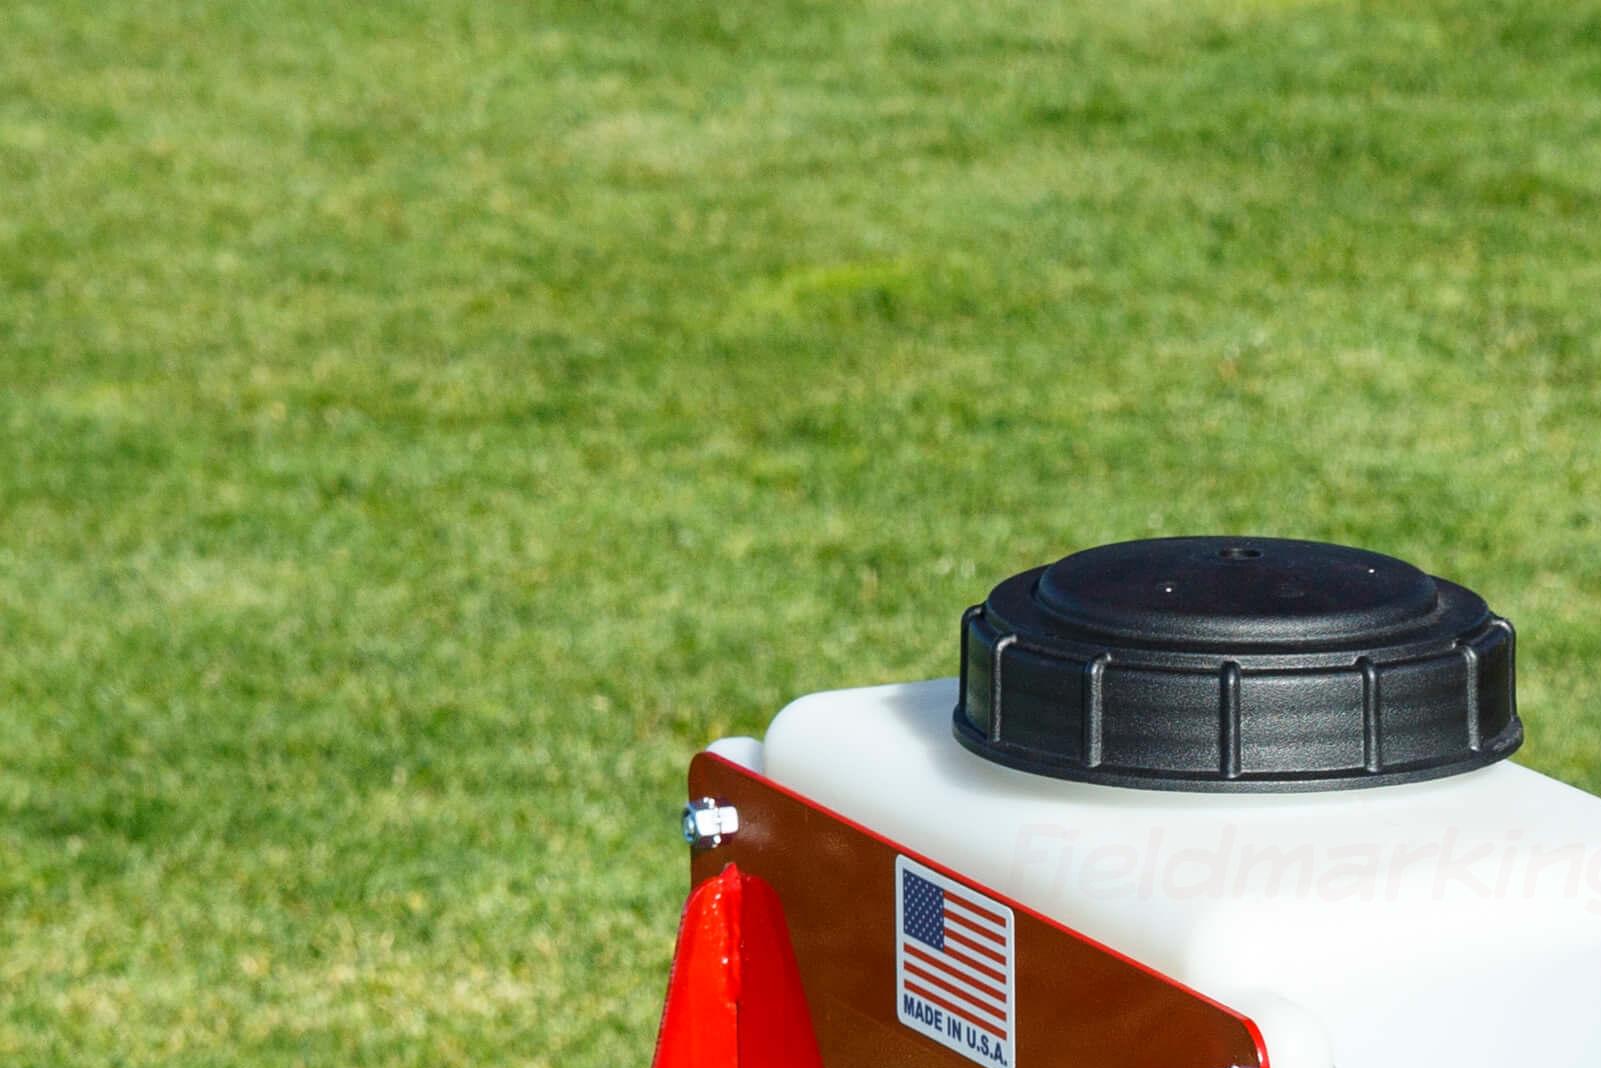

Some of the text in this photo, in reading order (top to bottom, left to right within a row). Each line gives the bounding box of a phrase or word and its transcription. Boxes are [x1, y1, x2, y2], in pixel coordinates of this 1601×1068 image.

[903, 993, 1009, 1067] MADE IN U.S.A.
